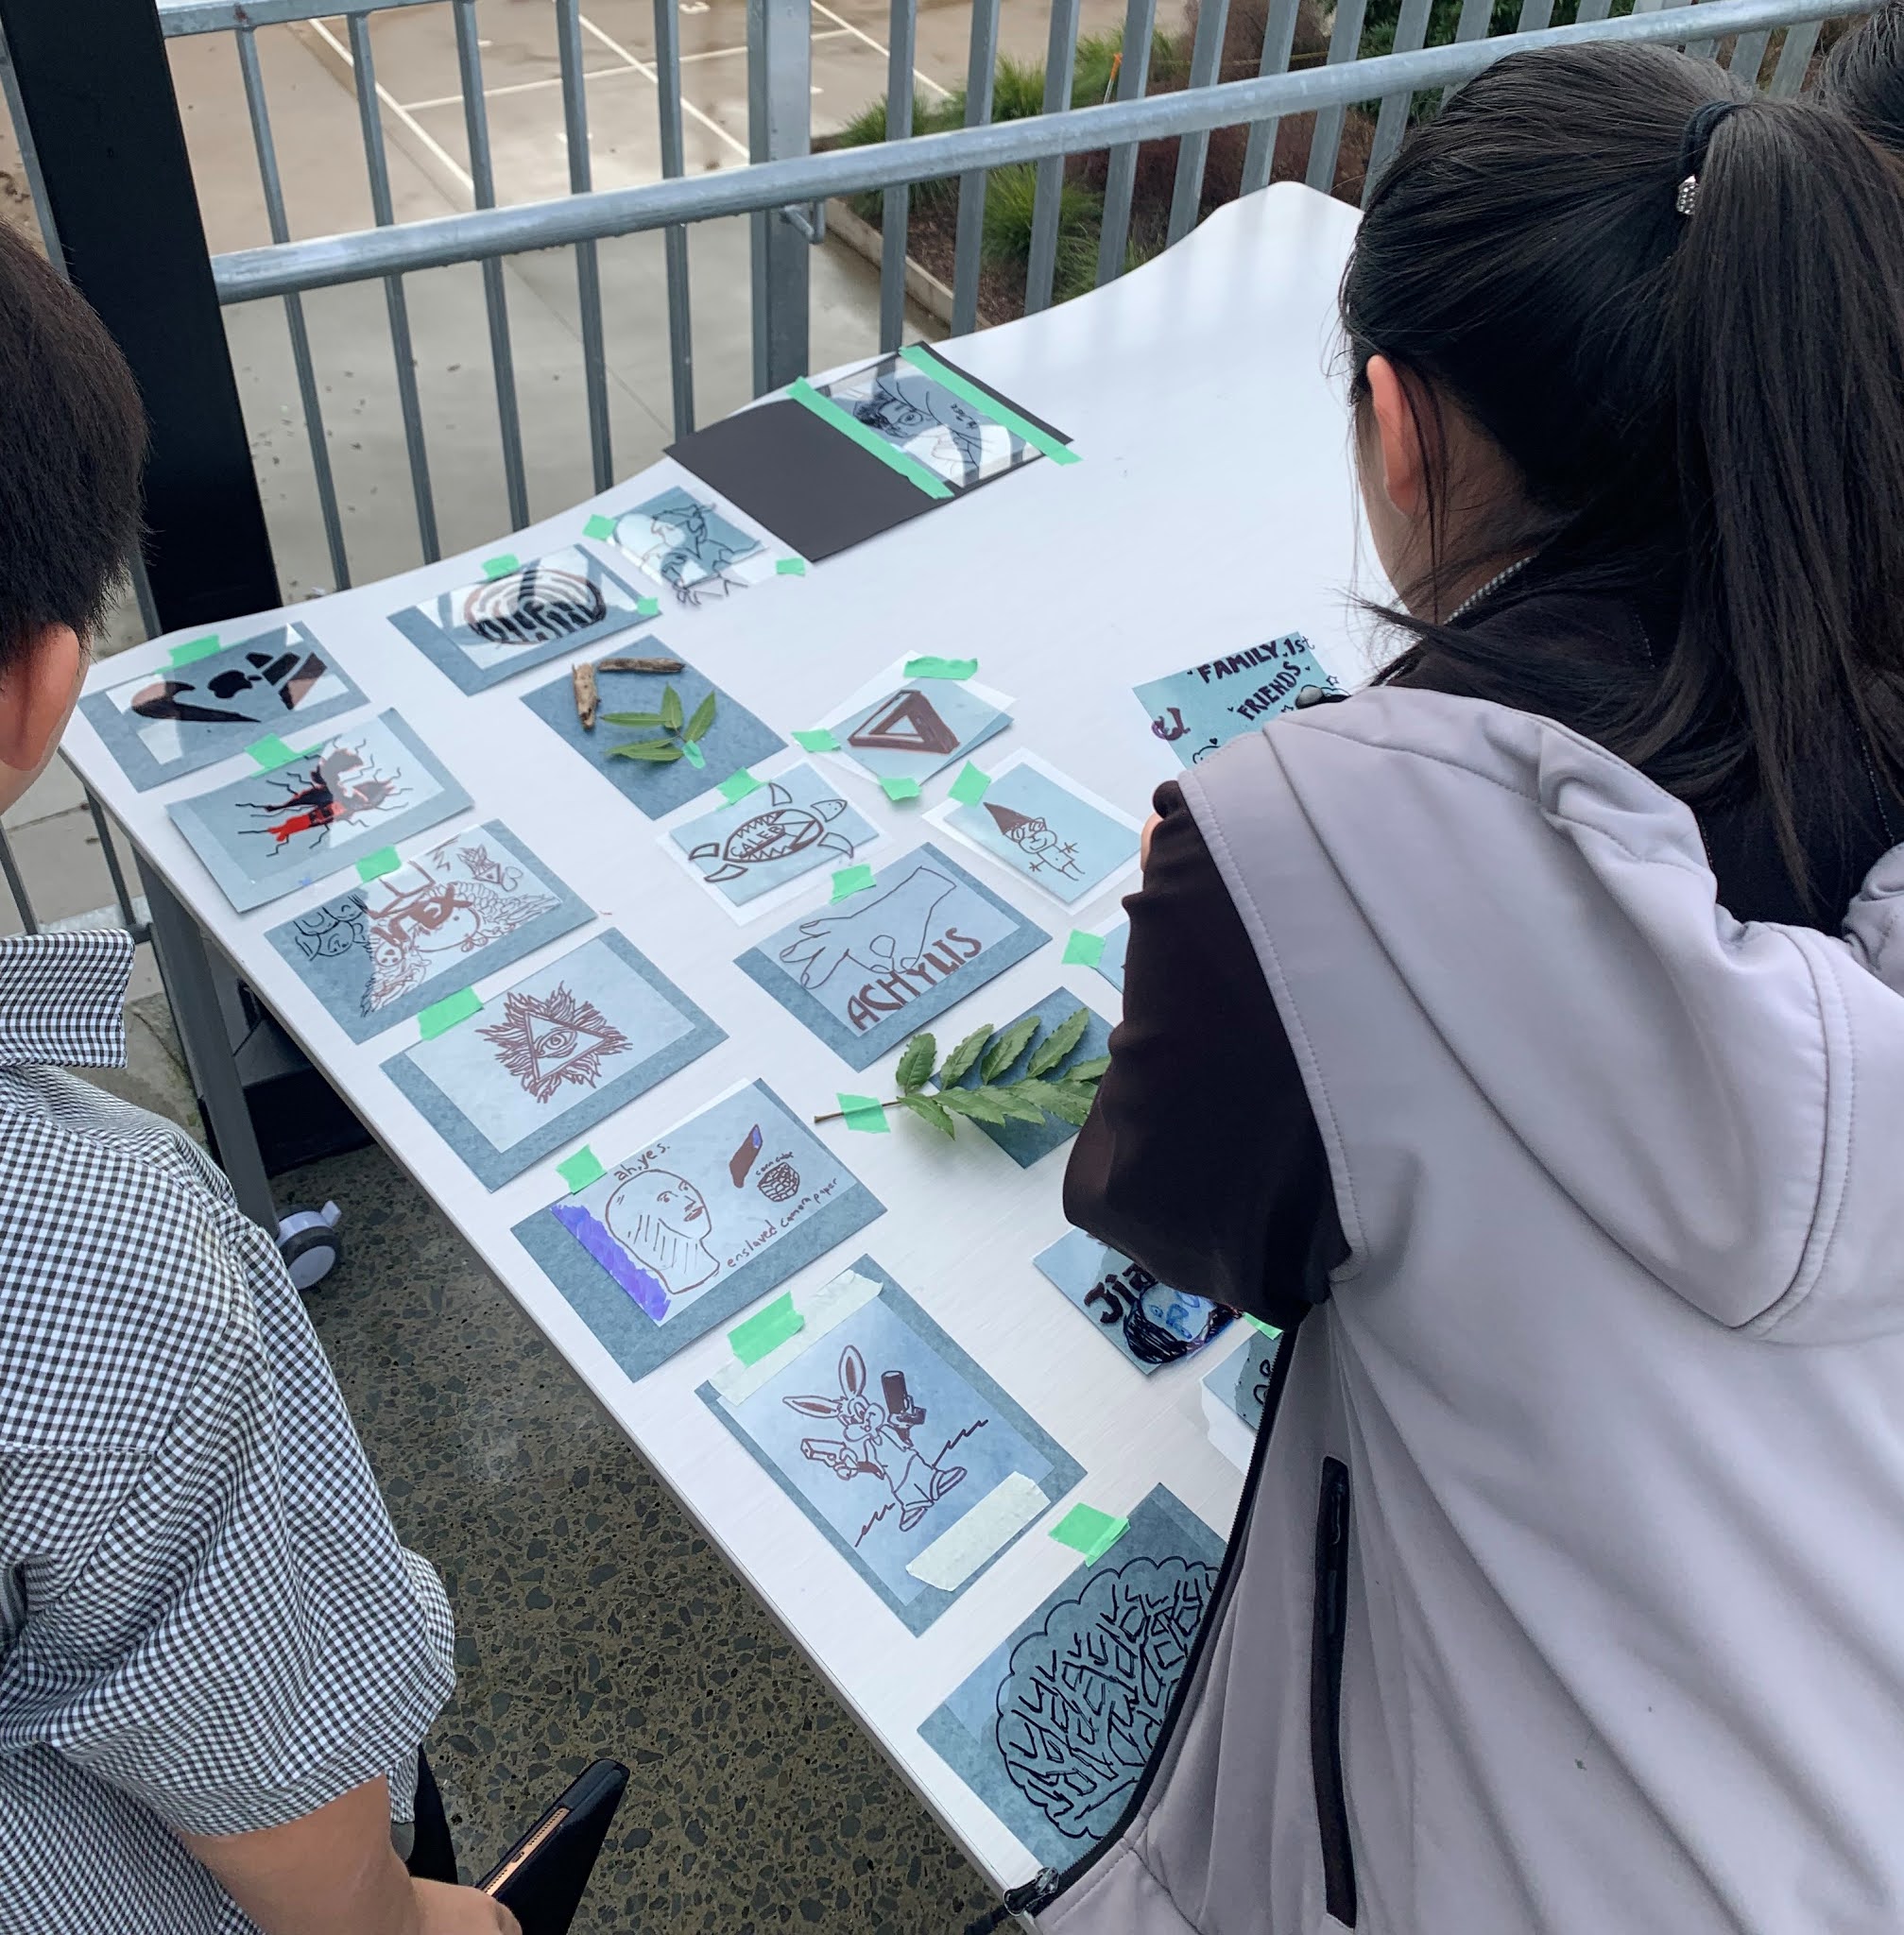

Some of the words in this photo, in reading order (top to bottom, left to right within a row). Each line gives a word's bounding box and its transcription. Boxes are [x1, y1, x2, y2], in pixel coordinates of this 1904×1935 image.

[1196, 640, 1279, 684] FAMILY
[1282, 636, 1315, 656] 1st
[1236, 660, 1301, 721] FRIENDS
[847, 927, 983, 1032] ACHYLIS
[727, 1219, 778, 1268] enslaved
[814, 1177, 838, 1205] paper
